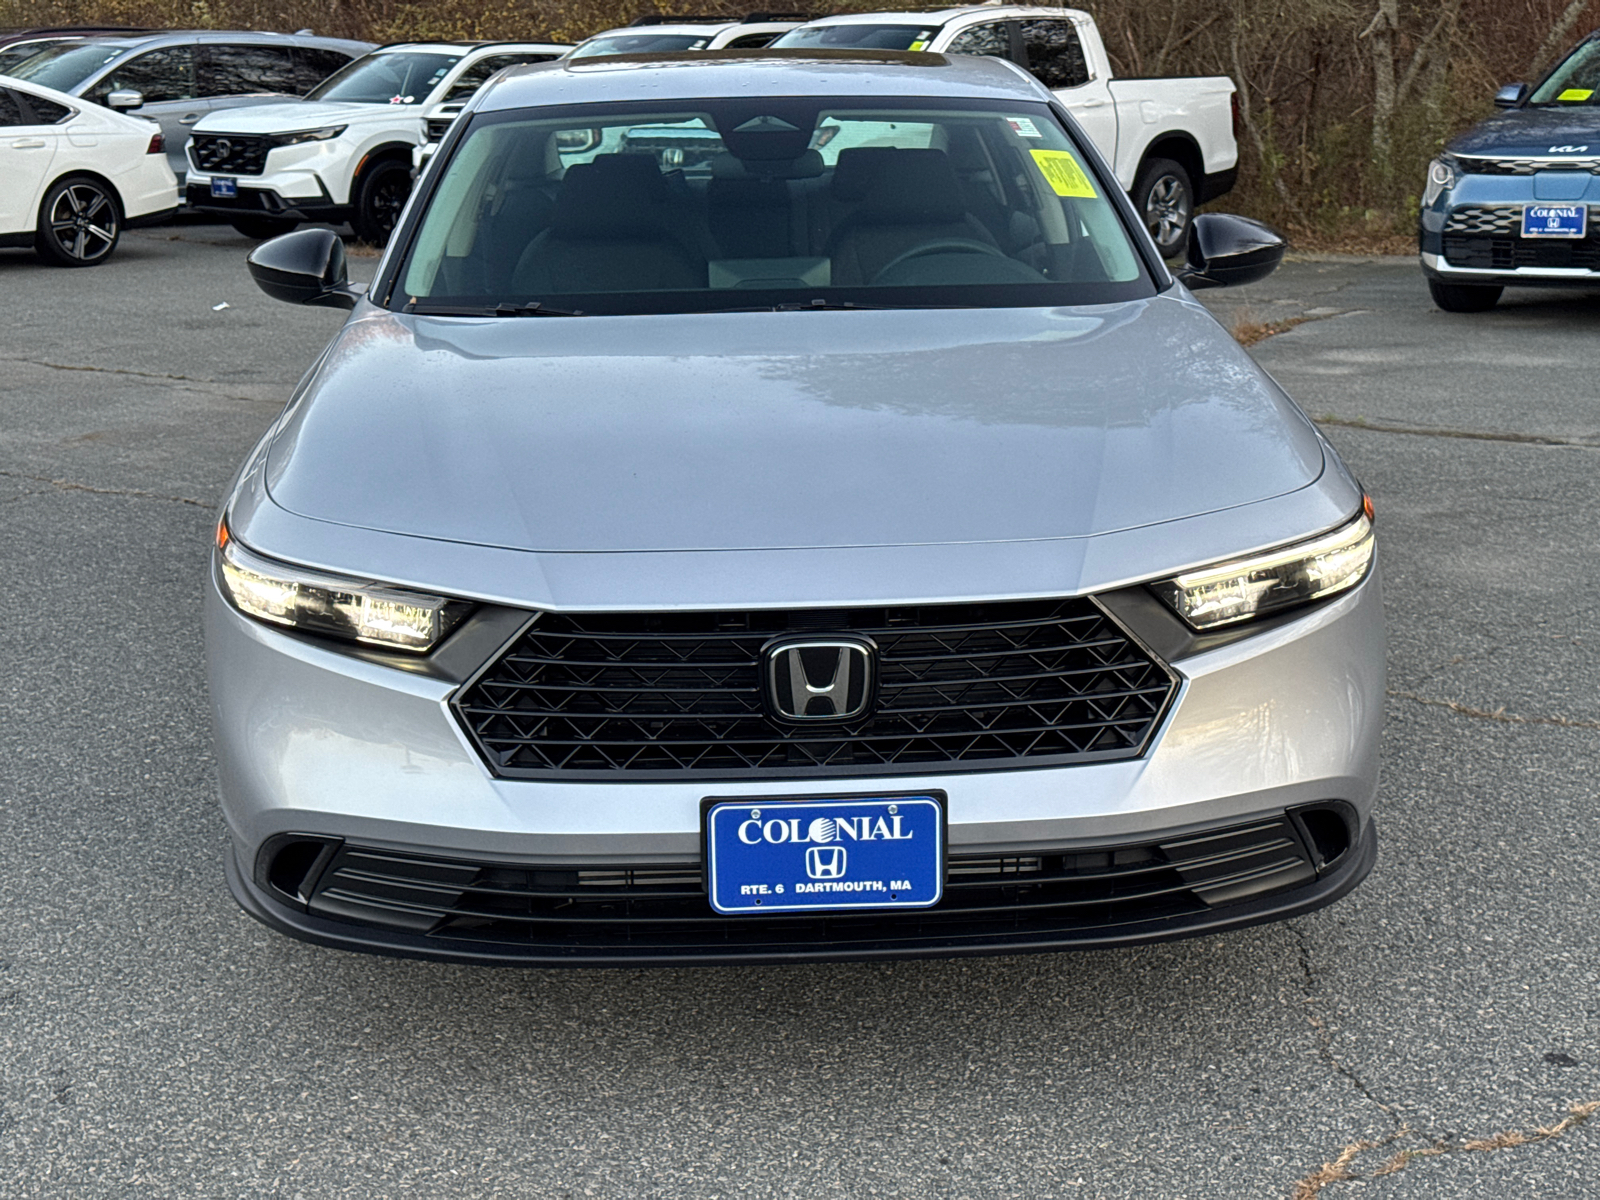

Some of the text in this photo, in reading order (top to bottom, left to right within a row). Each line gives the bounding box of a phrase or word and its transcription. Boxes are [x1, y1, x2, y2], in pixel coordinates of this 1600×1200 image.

[1530, 208, 1578, 217] COLONIAL
[738, 815, 913, 845] COLONIAL
[741, 880, 912, 895] RTE. 6 DARTMOUTH, MA
